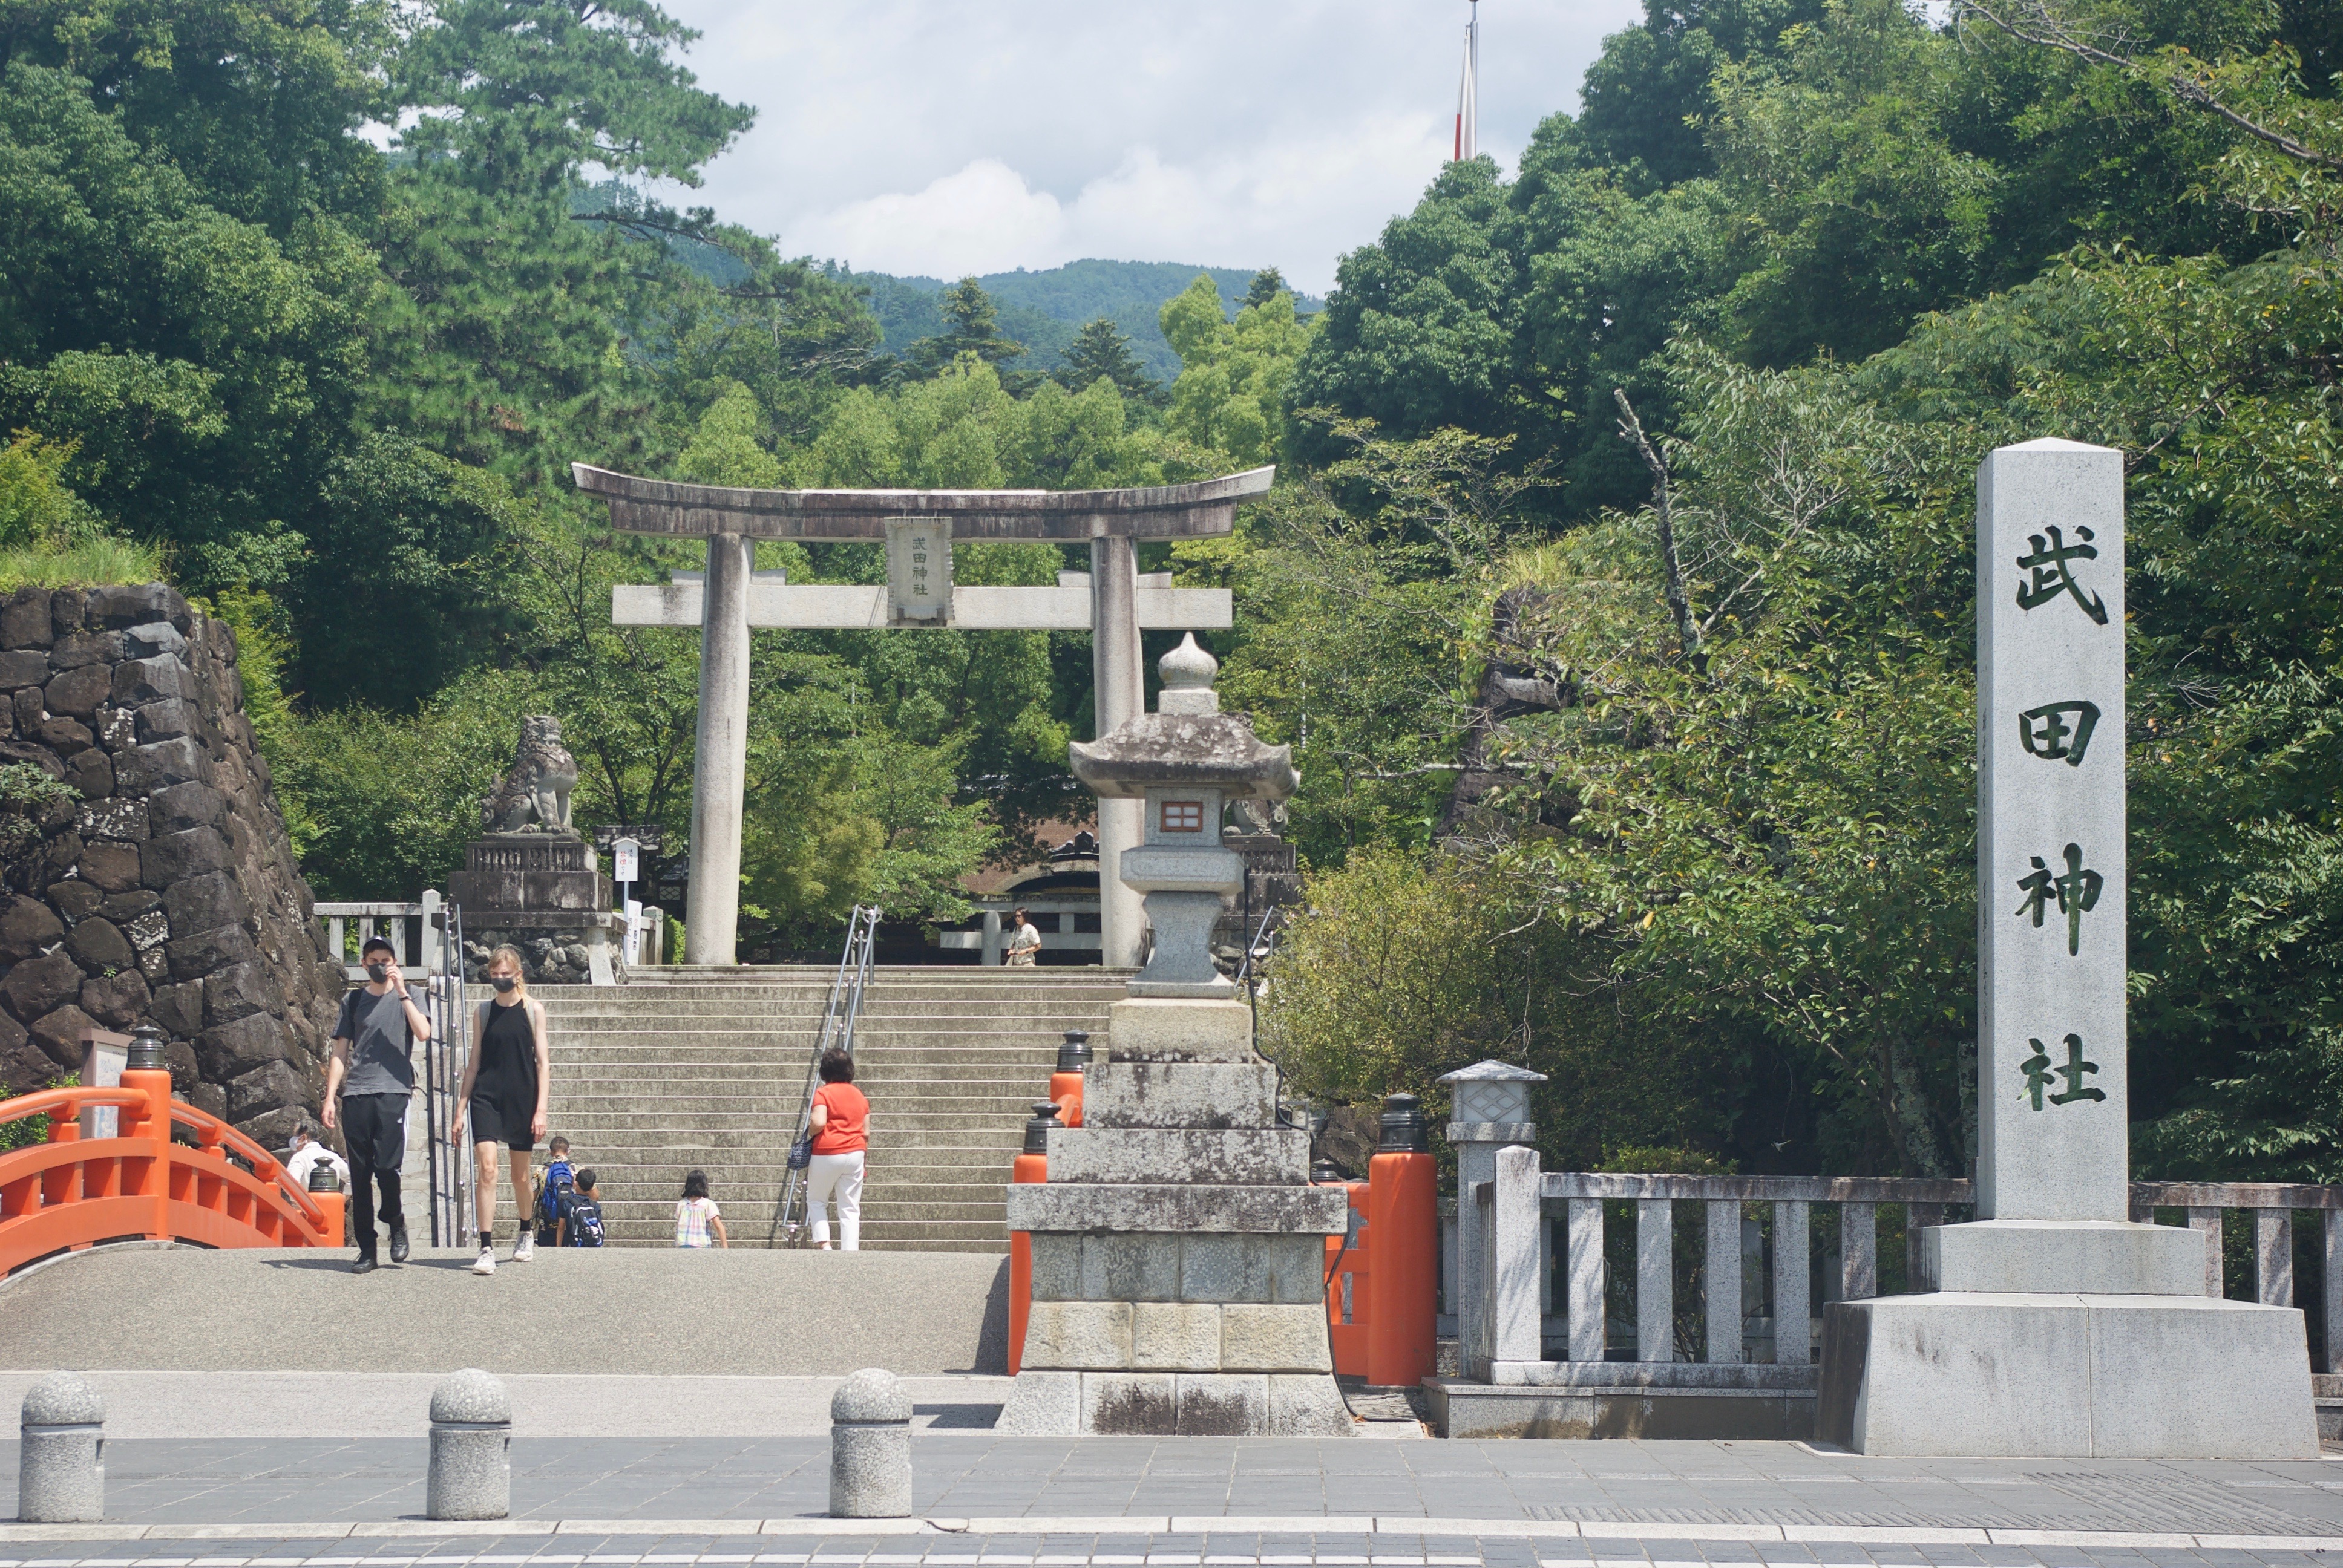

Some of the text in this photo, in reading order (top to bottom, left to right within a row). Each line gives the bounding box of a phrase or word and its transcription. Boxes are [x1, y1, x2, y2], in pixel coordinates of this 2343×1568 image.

[912, 537, 928, 596] 武田神社
[2015, 525, 2109, 1112] 武田神社
